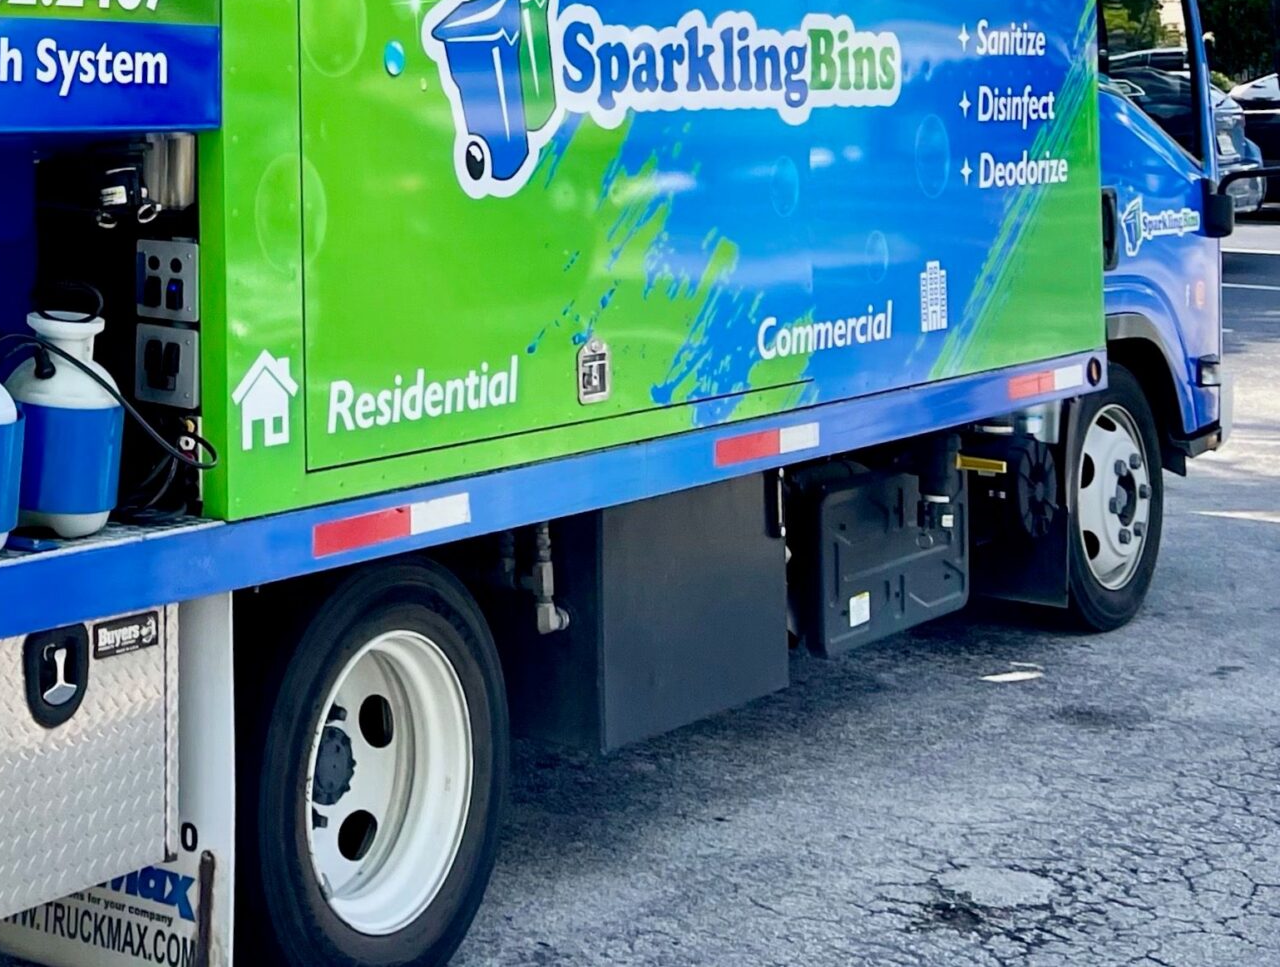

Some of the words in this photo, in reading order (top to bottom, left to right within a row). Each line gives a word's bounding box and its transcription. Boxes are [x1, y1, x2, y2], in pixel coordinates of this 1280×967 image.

[976, 19, 1046, 56] Sanitize
[36, 38, 168, 96] System
[562, 21, 895, 109] SparklingBins
[978, 85, 1055, 130] Disinfect
[979, 150, 1068, 189] Deodorize
[757, 299, 893, 360] Commercial
[327, 354, 518, 434] Residential
[98, 624, 140, 648] Buyers
[87, 892, 101, 905] for
[104, 898, 125, 912] your
[129, 905, 173, 927] company
